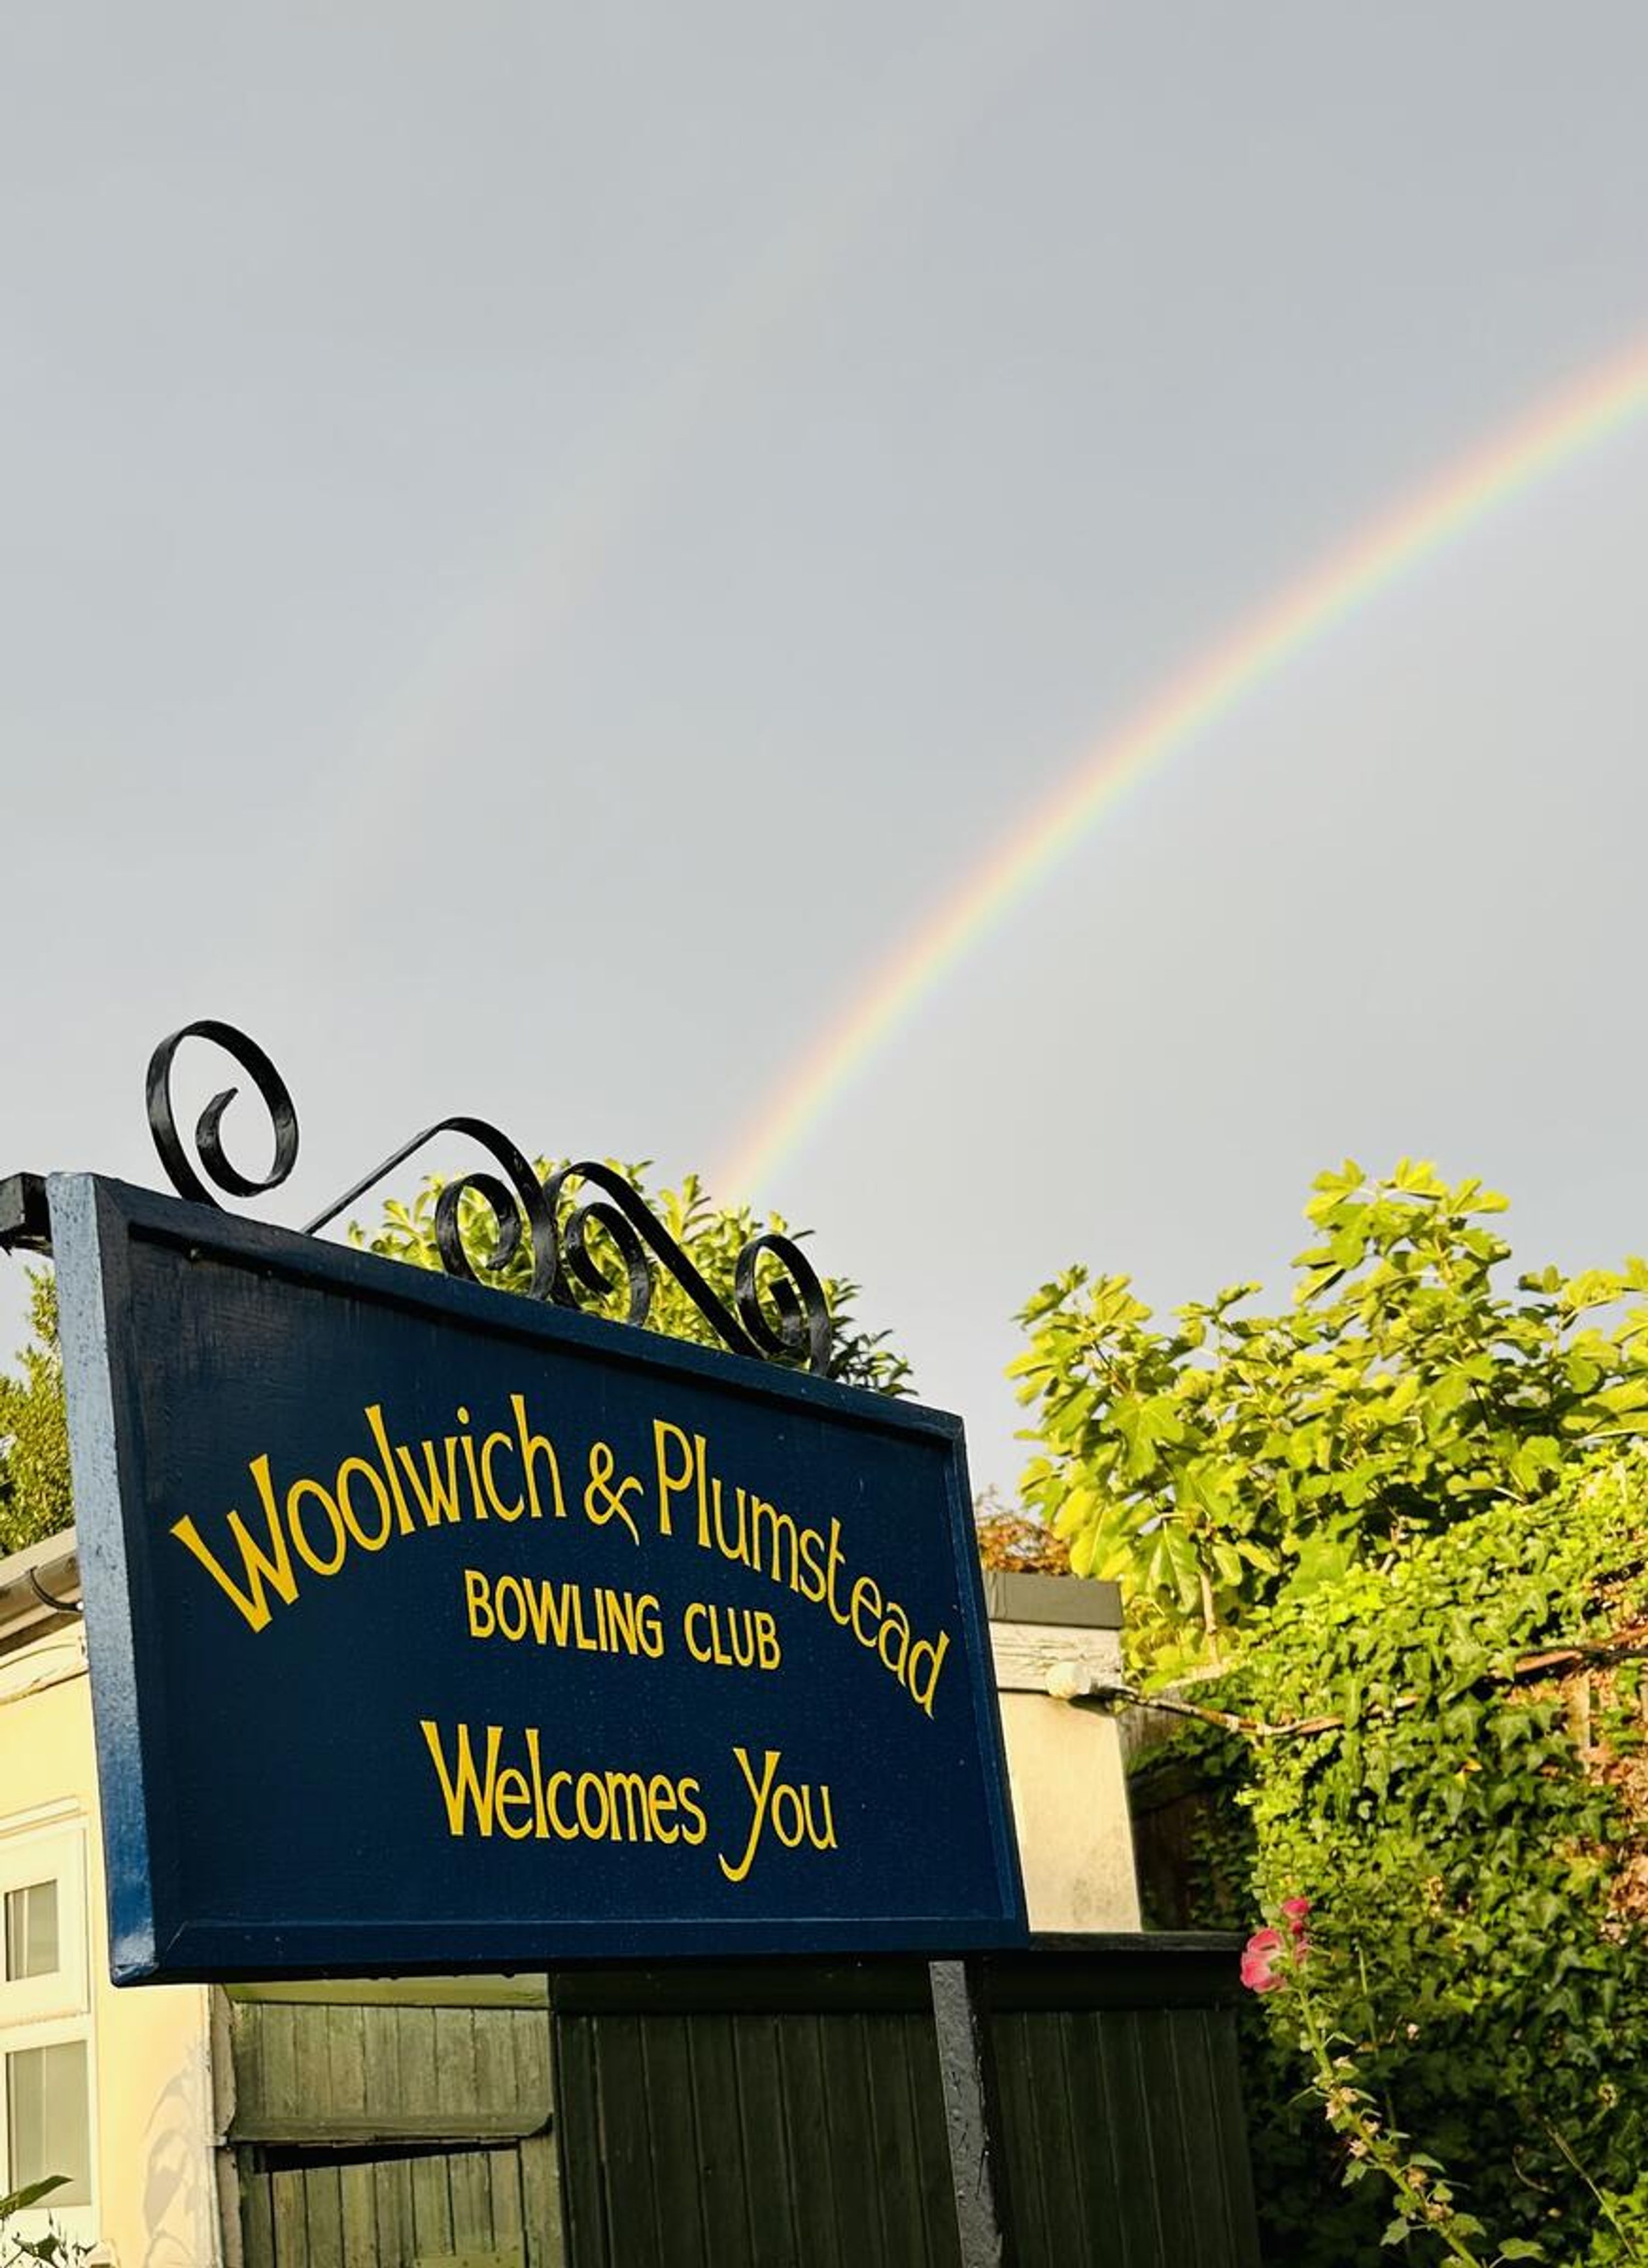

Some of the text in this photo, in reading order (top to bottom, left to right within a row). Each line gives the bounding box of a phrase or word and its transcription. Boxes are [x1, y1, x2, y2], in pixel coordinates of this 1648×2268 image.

[171, 1393, 950, 1719] Woolwich & Plumstead
[464, 1570, 781, 1670] BOWLING CLUB
[421, 1720, 837, 1882] Welcomes You
